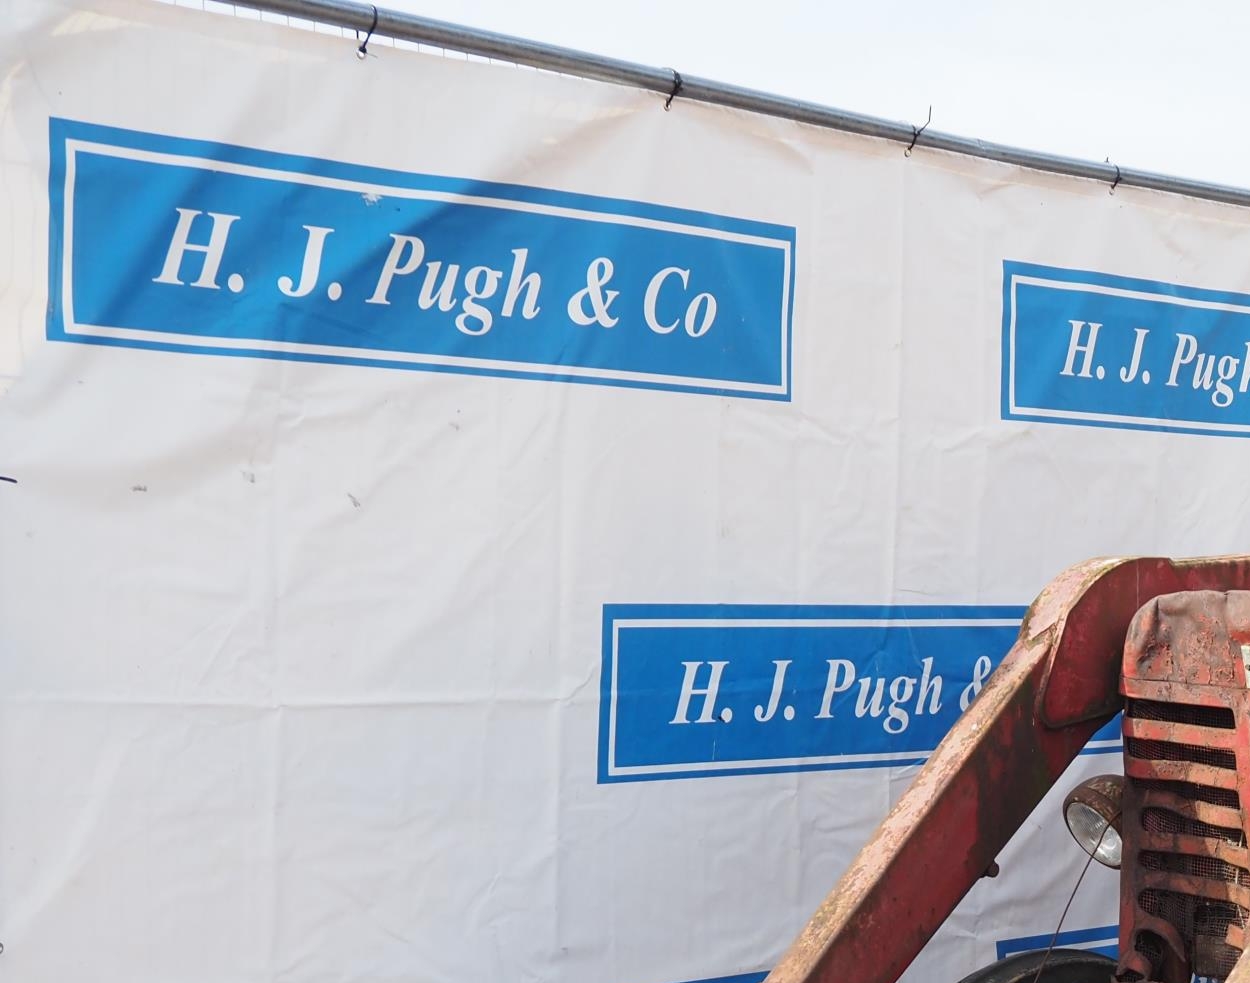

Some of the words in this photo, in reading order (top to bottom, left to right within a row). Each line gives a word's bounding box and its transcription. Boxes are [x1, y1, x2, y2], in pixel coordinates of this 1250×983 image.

[153, 207, 244, 292] H.
[277, 225, 342, 301] J.
[366, 233, 542, 336] Pugh
[567, 257, 620, 328] &
[643, 267, 717, 338] Co
[1060, 319, 1105, 380] H.
[1119, 328, 1151, 385] J.
[669, 661, 733, 724] H.
[754, 660, 795, 722] J.
[815, 656, 943, 734] Pugh
